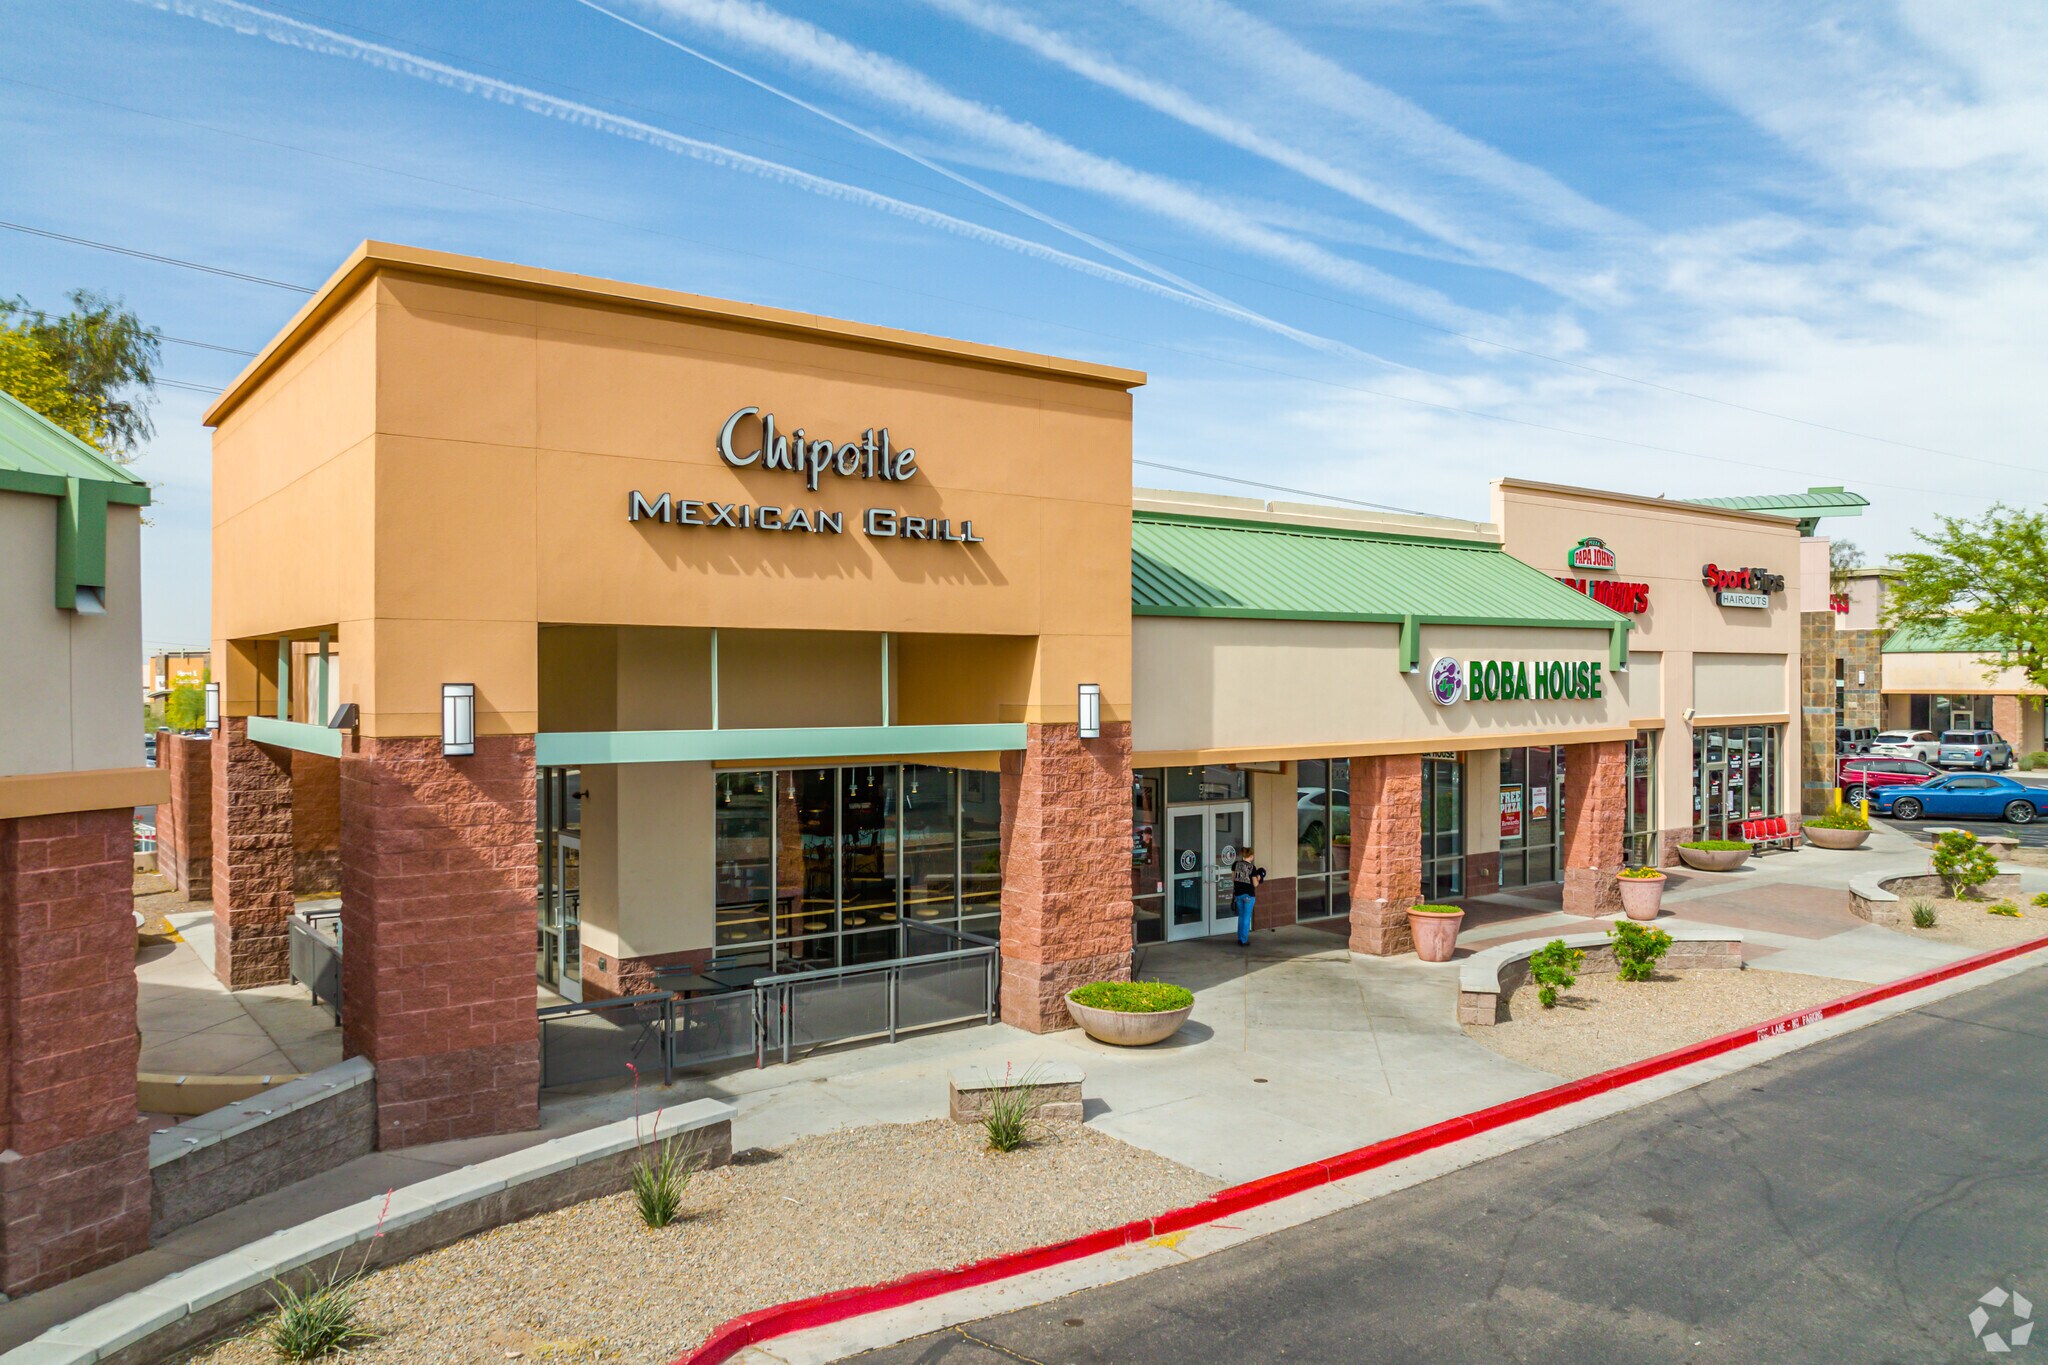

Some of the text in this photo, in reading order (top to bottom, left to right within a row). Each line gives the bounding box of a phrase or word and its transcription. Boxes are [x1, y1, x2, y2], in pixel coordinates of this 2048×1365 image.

[717, 406, 918, 491] Chipotle
[629, 490, 984, 542] MEXICAN GRILL
[1575, 548, 1592, 565] PAPA
[1723, 595, 1767, 606] HAIRCUTS
[1469, 660, 1602, 701] BOBA HOUSE
[1500, 791, 1521, 804] FREE
[1500, 802, 1521, 814] PIZZA
[1771, 1022, 1786, 1036] LANE
[1791, 1017, 1800, 1030] NO
[1801, 1010, 1823, 1026] PARKING
